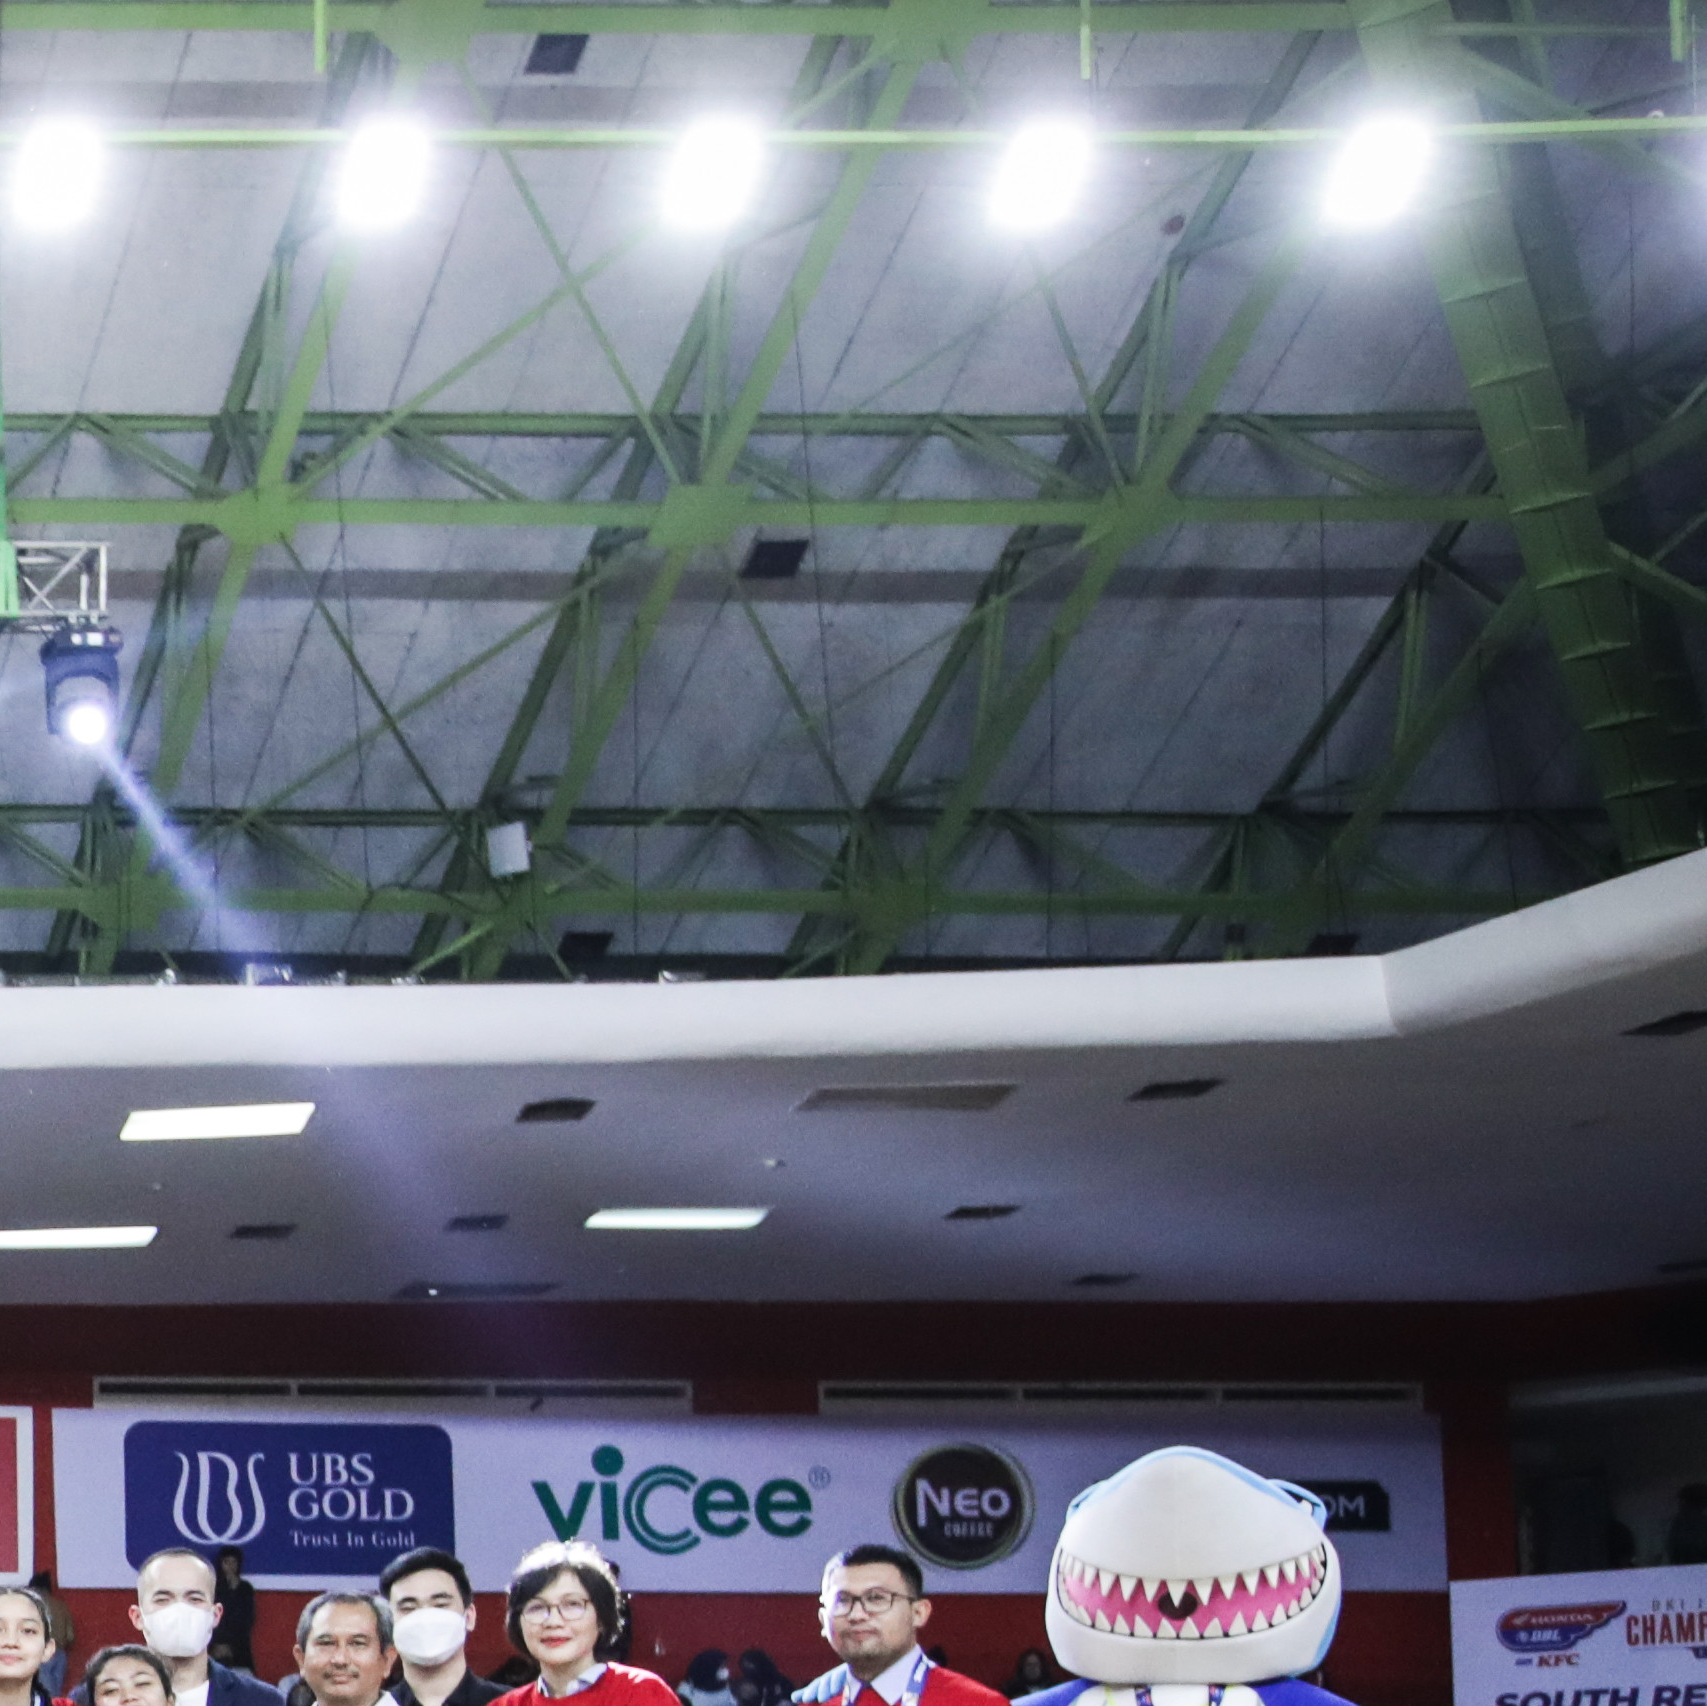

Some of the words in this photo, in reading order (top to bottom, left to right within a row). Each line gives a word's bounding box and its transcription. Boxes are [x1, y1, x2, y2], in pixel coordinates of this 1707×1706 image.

[289, 1453, 375, 1485] UBS
[288, 1489, 415, 1522] GOLD
[915, 1478, 1011, 1528] NEO
[289, 1530, 339, 1547] Trust
[346, 1530, 365, 1547] In
[371, 1530, 415, 1547] Gold
[1537, 1654, 1580, 1667] KFC
